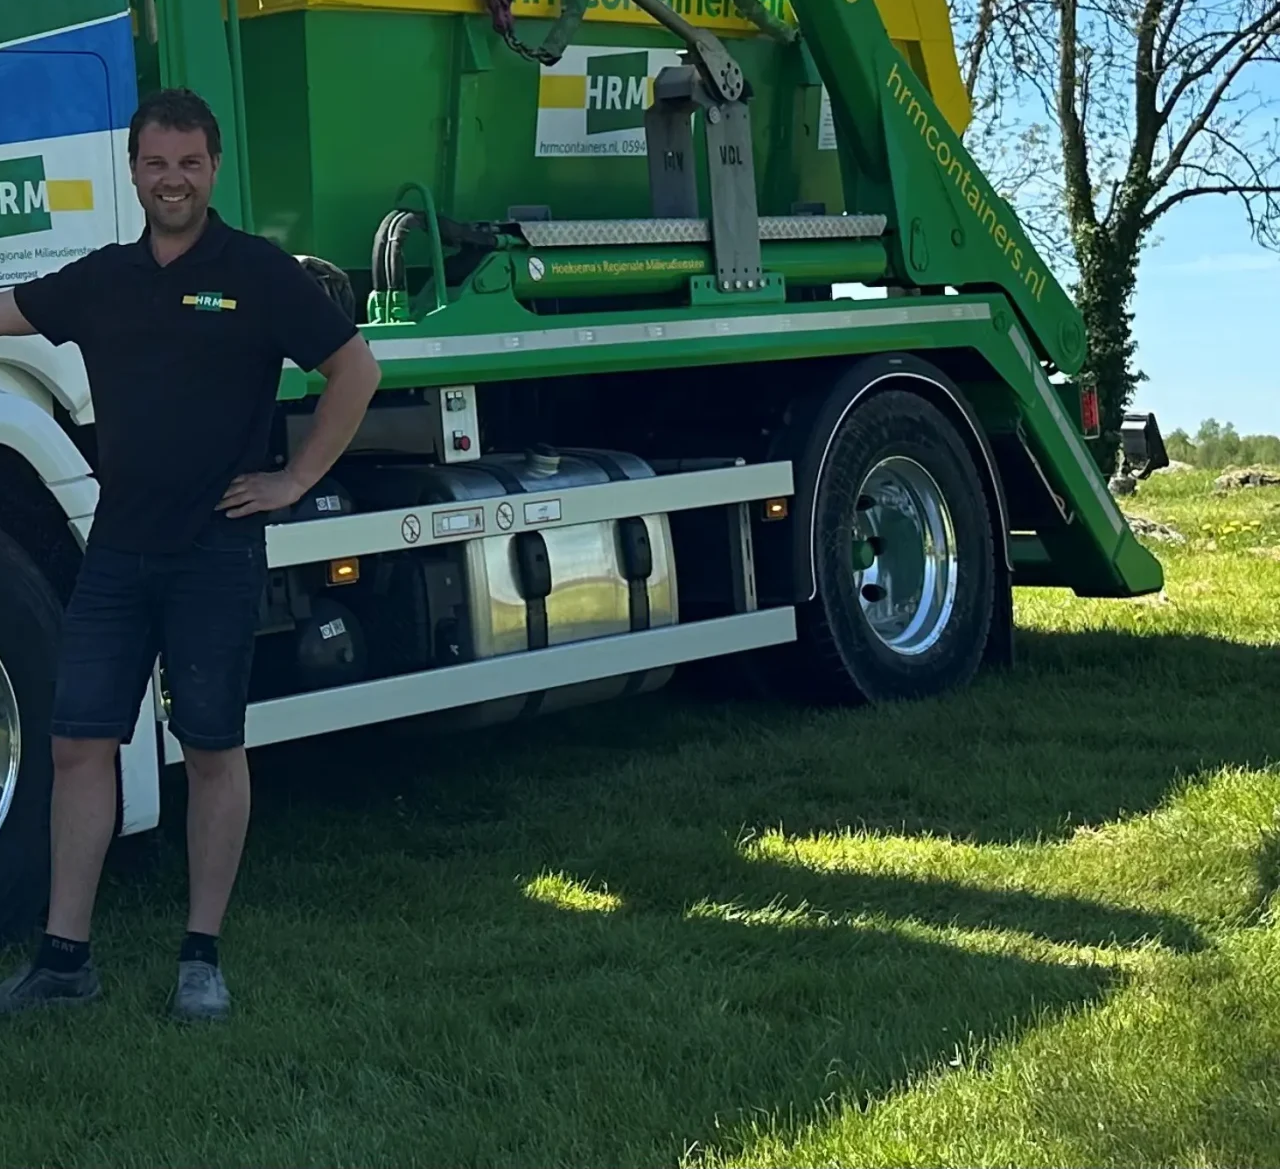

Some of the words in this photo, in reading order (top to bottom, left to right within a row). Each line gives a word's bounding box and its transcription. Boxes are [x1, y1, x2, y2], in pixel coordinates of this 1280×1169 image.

[586, 75, 649, 110] HRM
[719, 144, 743, 165] VDL
[886, 63, 1047, 302] hrmcontainers.nl
[603, 260, 645, 275] Regionale
[196, 296, 222, 307] HRM
